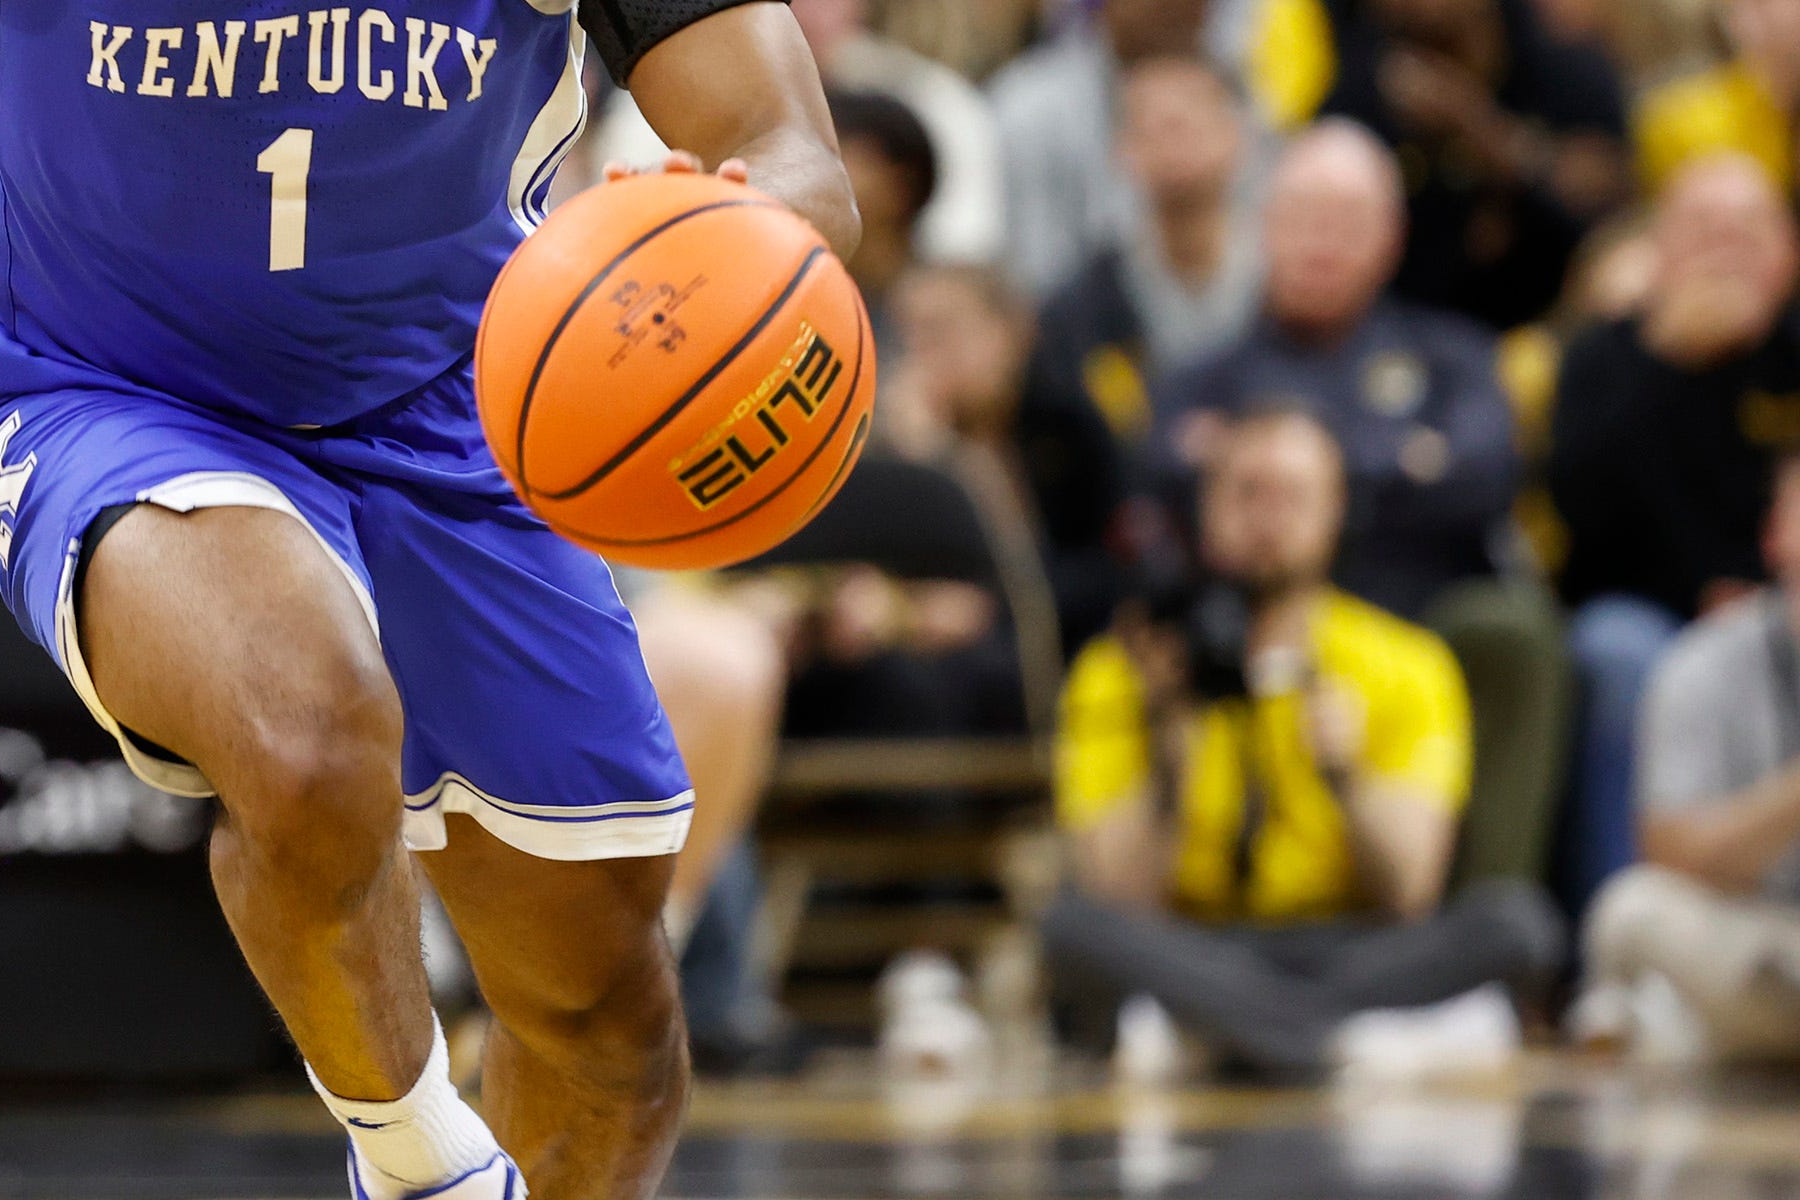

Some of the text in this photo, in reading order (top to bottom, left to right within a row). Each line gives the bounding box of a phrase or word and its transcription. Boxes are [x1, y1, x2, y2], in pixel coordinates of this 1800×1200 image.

[87, 7, 498, 112] KENTUCKY
[256, 128, 314, 272] 1
[674, 330, 845, 511] ELITE
